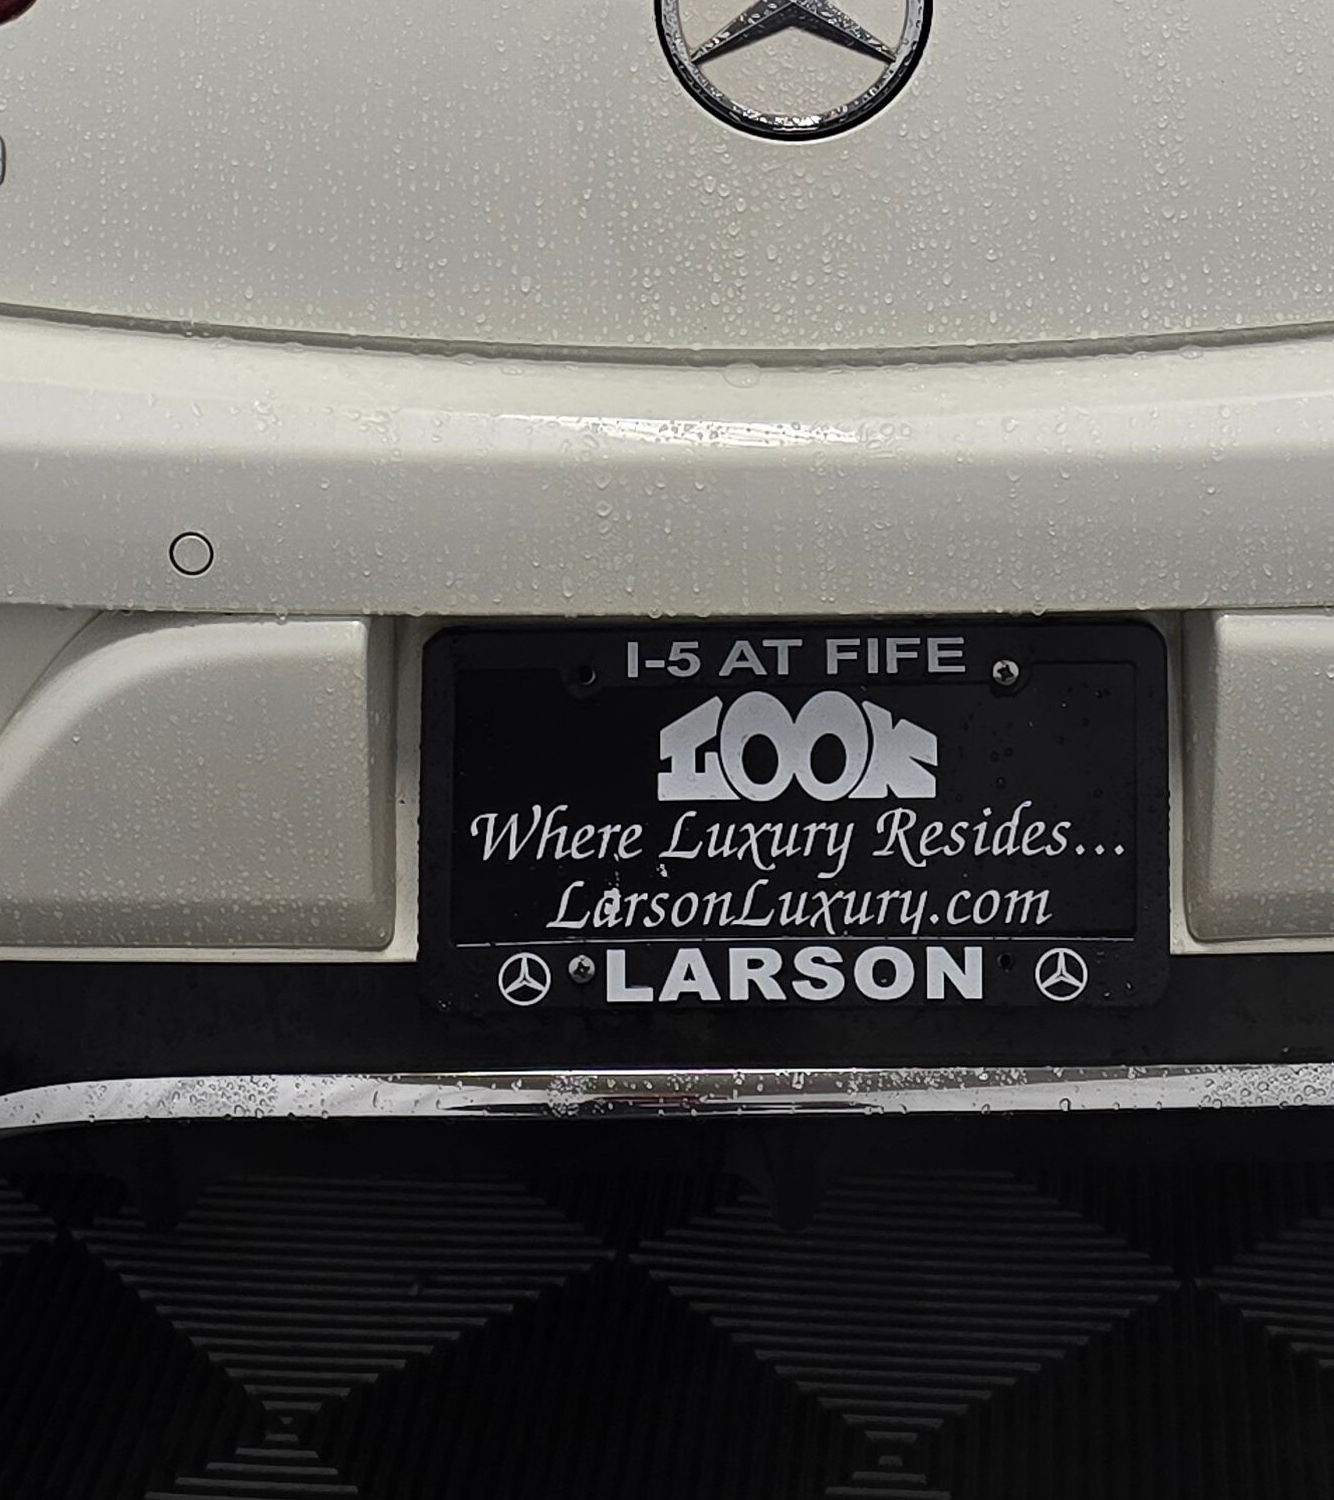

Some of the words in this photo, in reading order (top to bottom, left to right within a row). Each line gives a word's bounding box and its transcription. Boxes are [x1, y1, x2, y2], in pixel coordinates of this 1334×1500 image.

[626, 640, 701, 678] I-5
[719, 639, 803, 677] AT
[826, 636, 967, 675] FIFE
[470, 804, 643, 861] Where
[660, 810, 855, 878] Luxury
[873, 801, 1127, 867] Resides...
[546, 878, 1052, 934] LarsonLuxury.com
[605, 946, 984, 1002] LARSON
